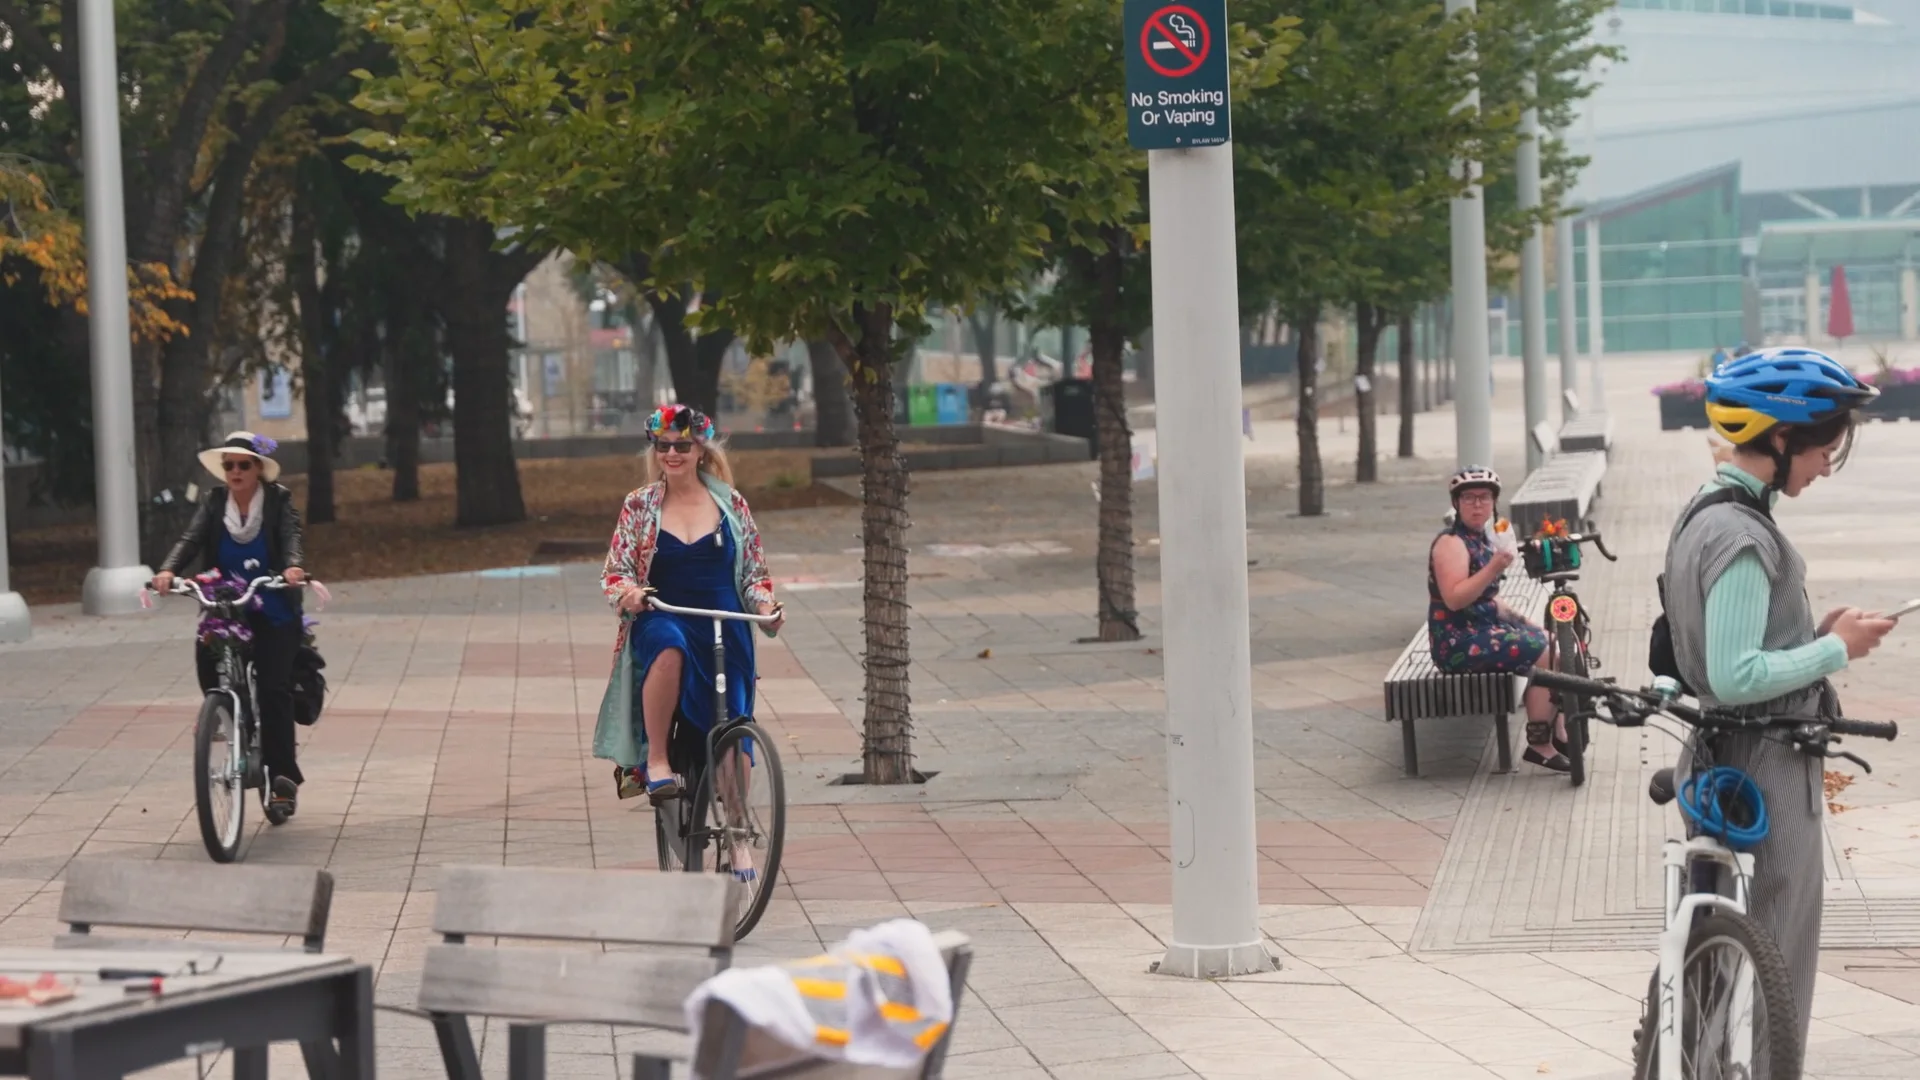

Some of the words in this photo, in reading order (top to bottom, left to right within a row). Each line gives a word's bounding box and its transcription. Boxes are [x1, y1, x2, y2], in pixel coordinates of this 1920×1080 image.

[1131, 91, 1153, 107] No
[1157, 88, 1224, 106] Smoking
[1141, 110, 1161, 126] Or
[1164, 108, 1216, 127] Vaping
